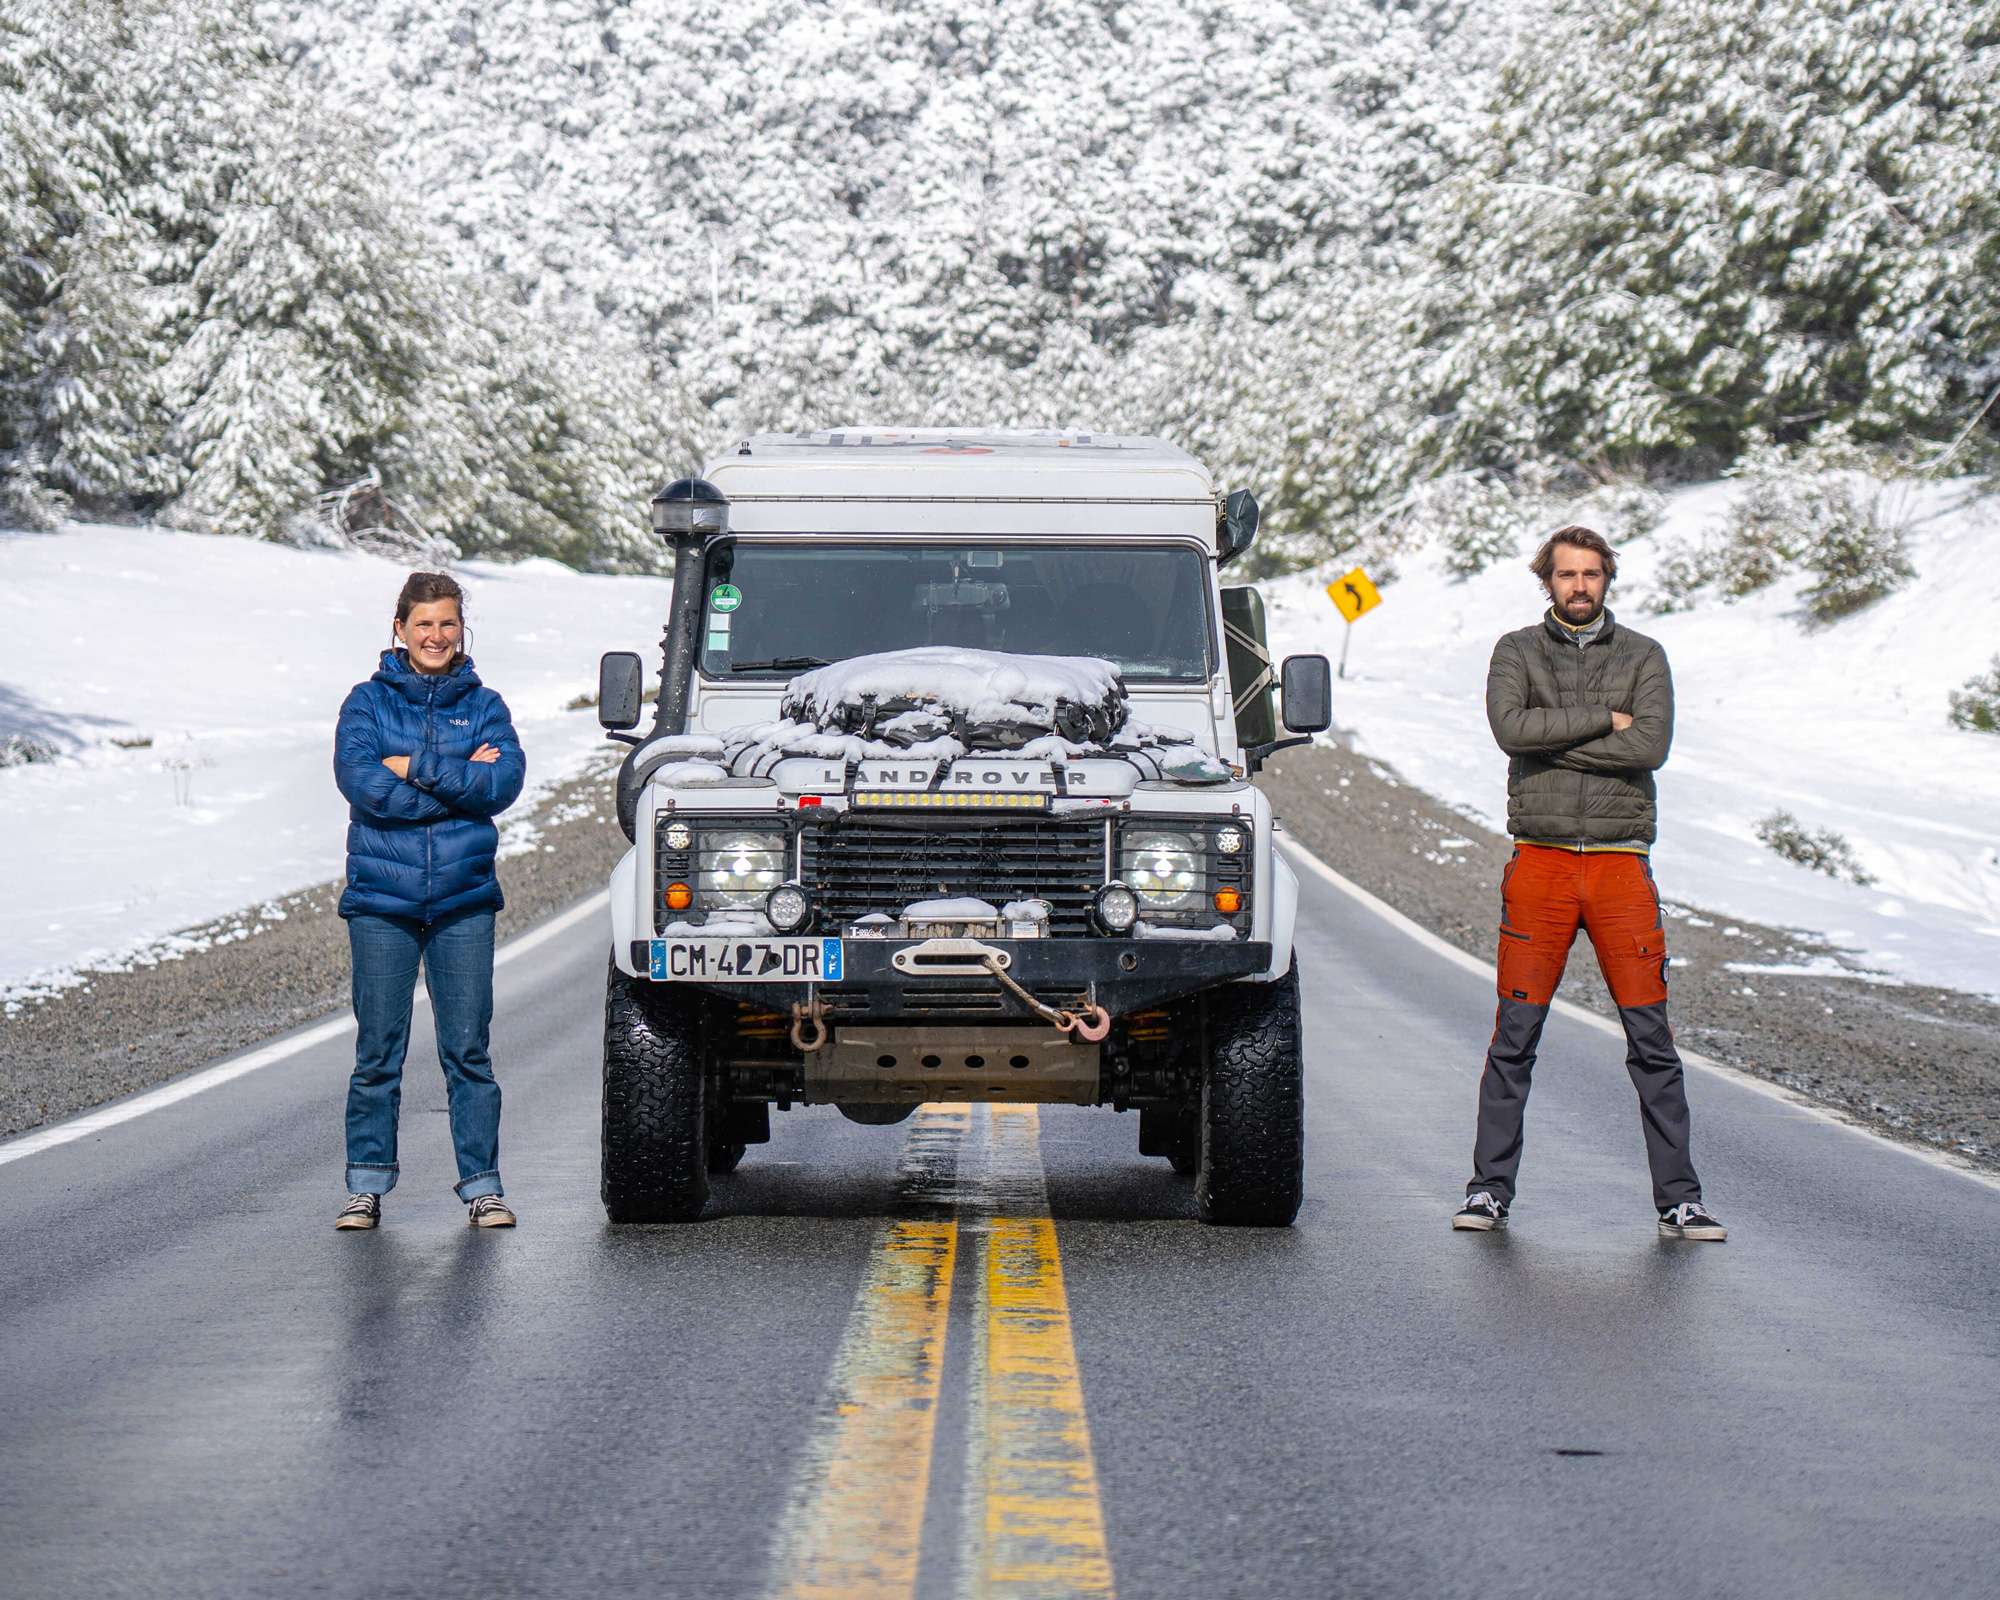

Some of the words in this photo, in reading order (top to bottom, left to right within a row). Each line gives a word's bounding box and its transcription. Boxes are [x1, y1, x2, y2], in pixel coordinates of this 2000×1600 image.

[722, 586, 731, 598] 4
[824, 771, 929, 783] LAND
[955, 772, 1086, 784] ROVER
[671, 944, 819, 976] CM-427DR
[654, 964, 662, 973] F
[828, 963, 836, 974] F
